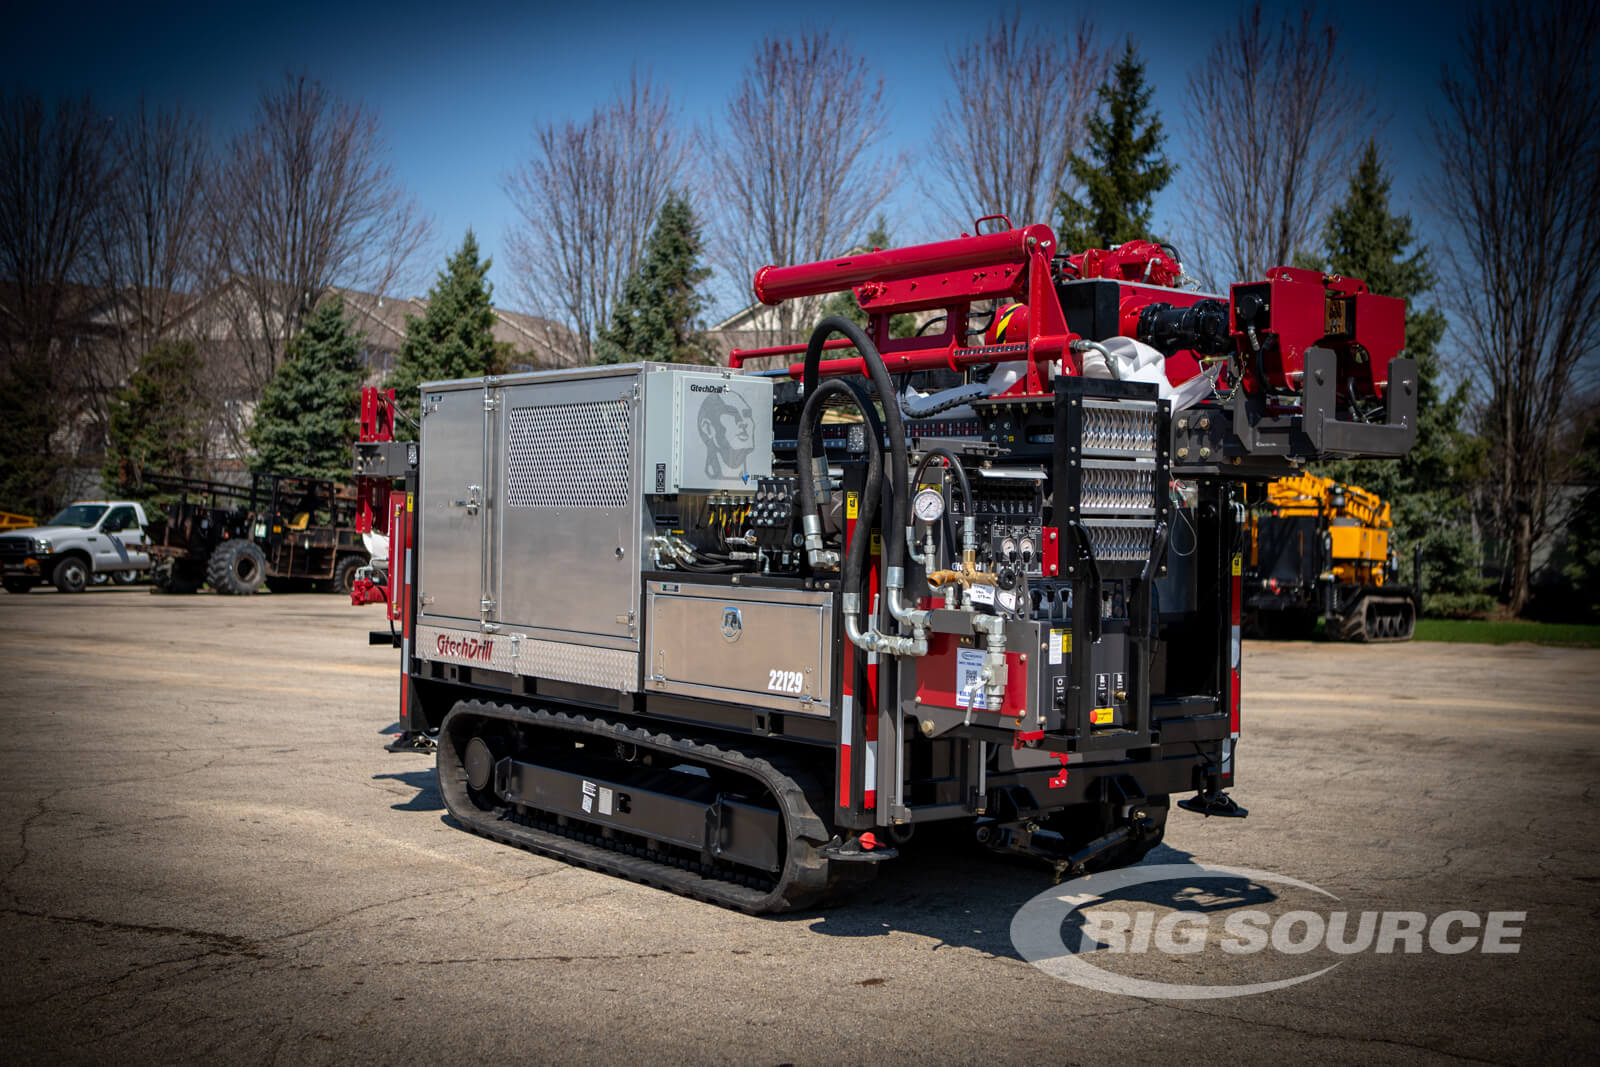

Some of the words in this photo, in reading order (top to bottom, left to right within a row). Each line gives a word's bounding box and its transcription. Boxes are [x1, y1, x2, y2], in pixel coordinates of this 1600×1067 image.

[690, 384, 723, 394] GtechDrill
[437, 634, 494, 662] GtechDrill
[767, 669, 804, 693] 22129
